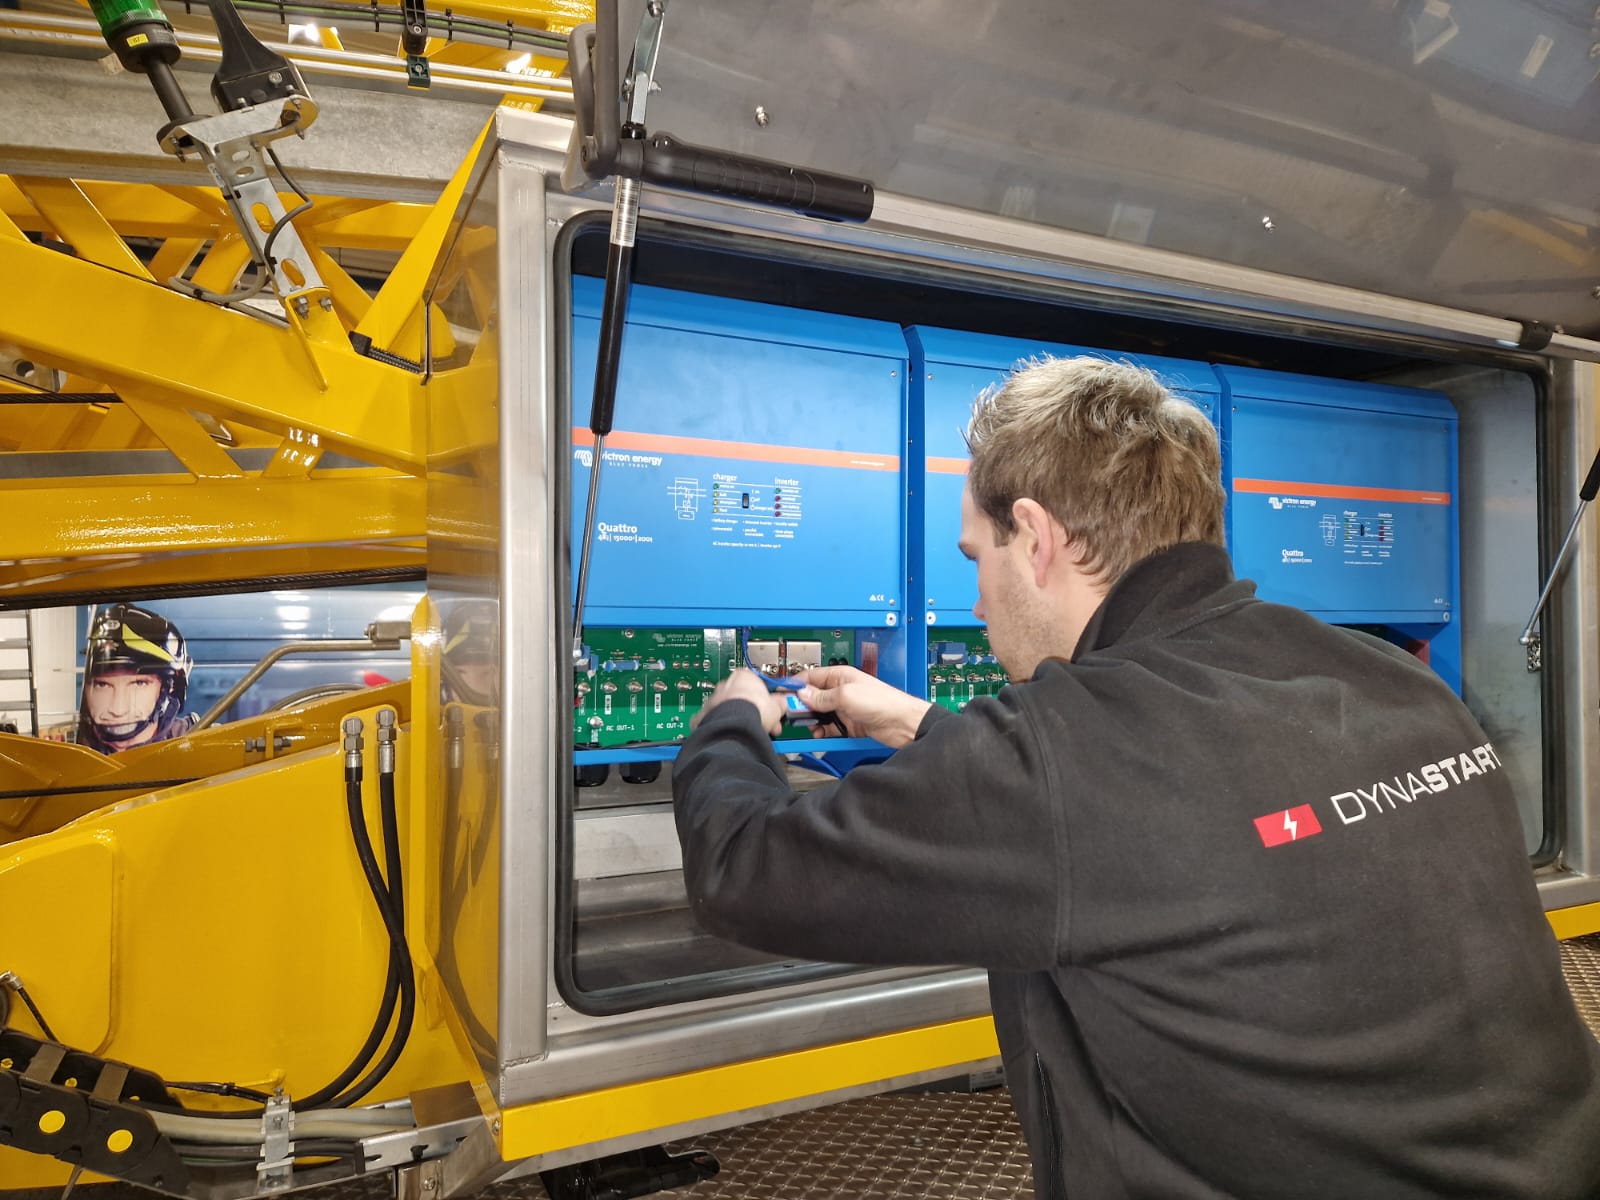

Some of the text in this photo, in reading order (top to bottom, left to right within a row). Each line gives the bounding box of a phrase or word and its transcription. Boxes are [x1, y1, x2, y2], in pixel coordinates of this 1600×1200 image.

[632, 455, 662, 466] energy
[598, 522, 638, 534] Quattro
[1330, 742, 1502, 825] DYNASTART
